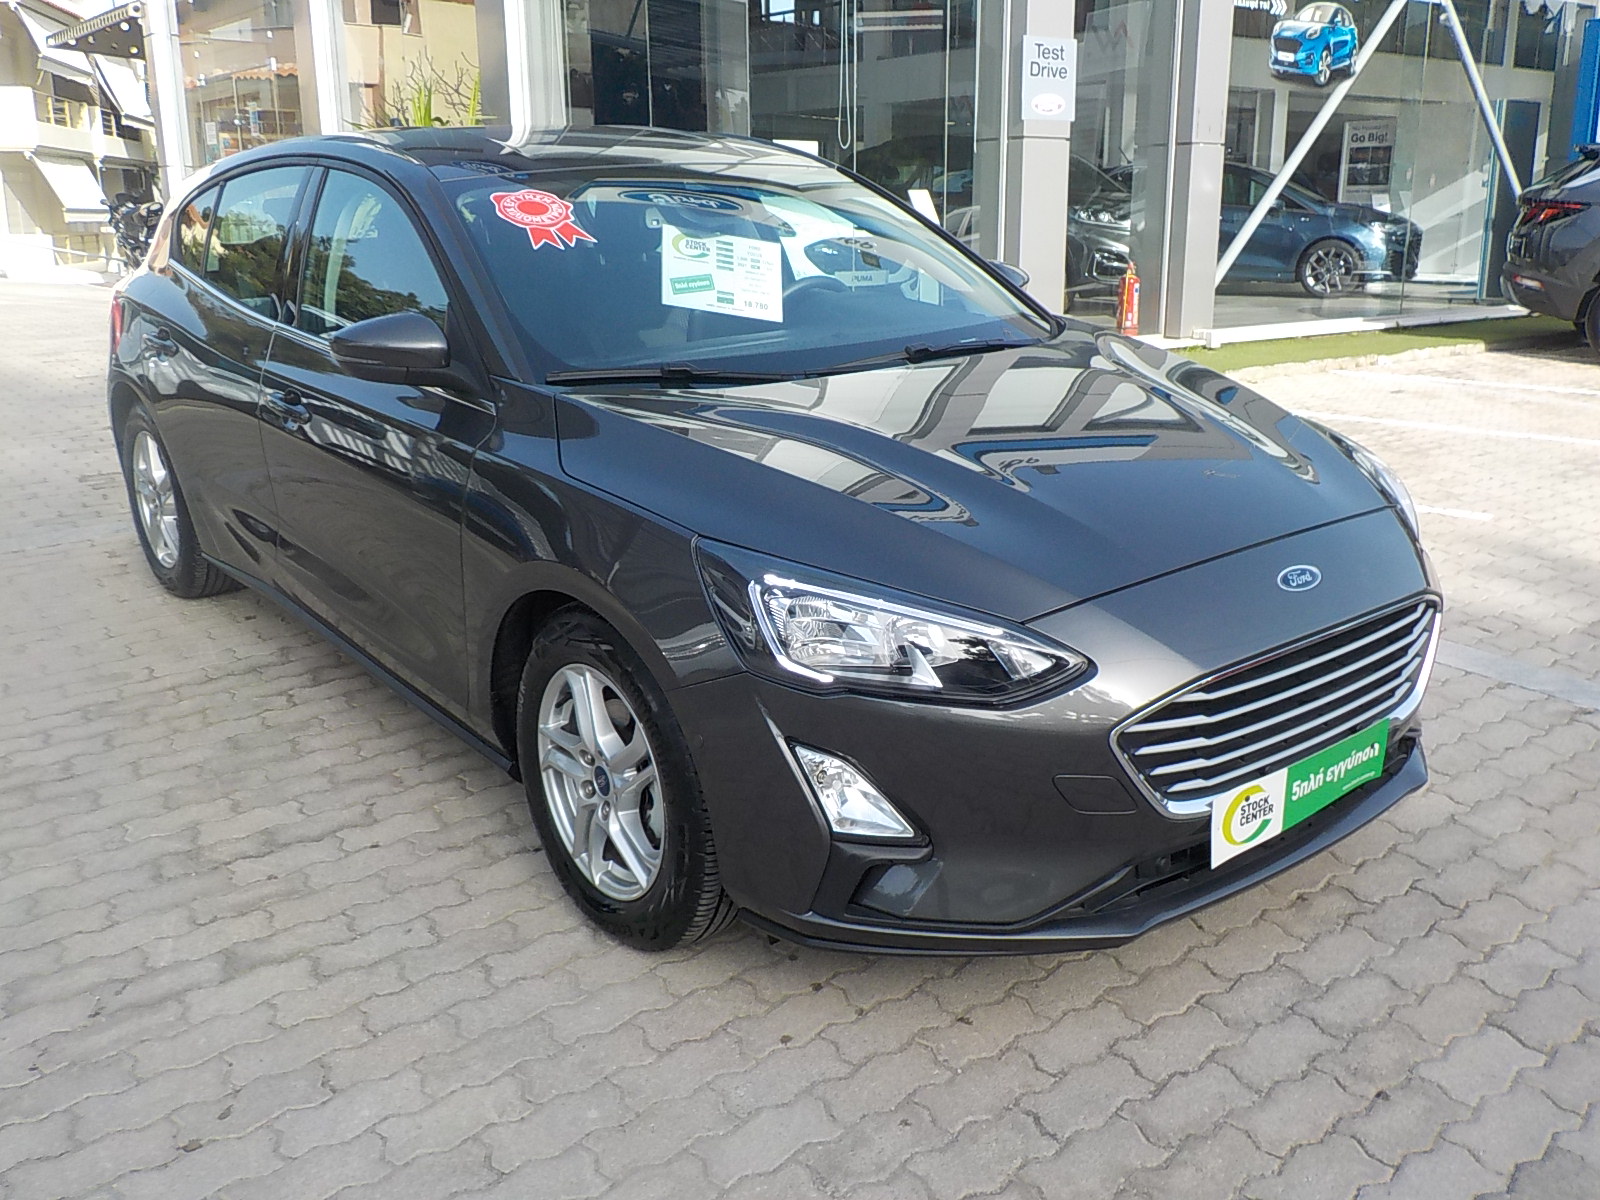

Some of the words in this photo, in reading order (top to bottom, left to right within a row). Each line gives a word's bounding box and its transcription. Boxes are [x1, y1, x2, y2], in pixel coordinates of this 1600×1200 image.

[1034, 43, 1065, 61] Test
[1030, 61, 1068, 79] Drive
[1351, 132, 1365, 143] Go
[1368, 131, 1388, 144] Big!
[685, 239, 707, 247] STOCK
[685, 244, 711, 252] CENTER
[1287, 570, 1313, 587] Ford
[1291, 767, 1324, 801] 5πλή
[1240, 795, 1270, 816] STOCK
[1239, 803, 1274, 827] CENTER
